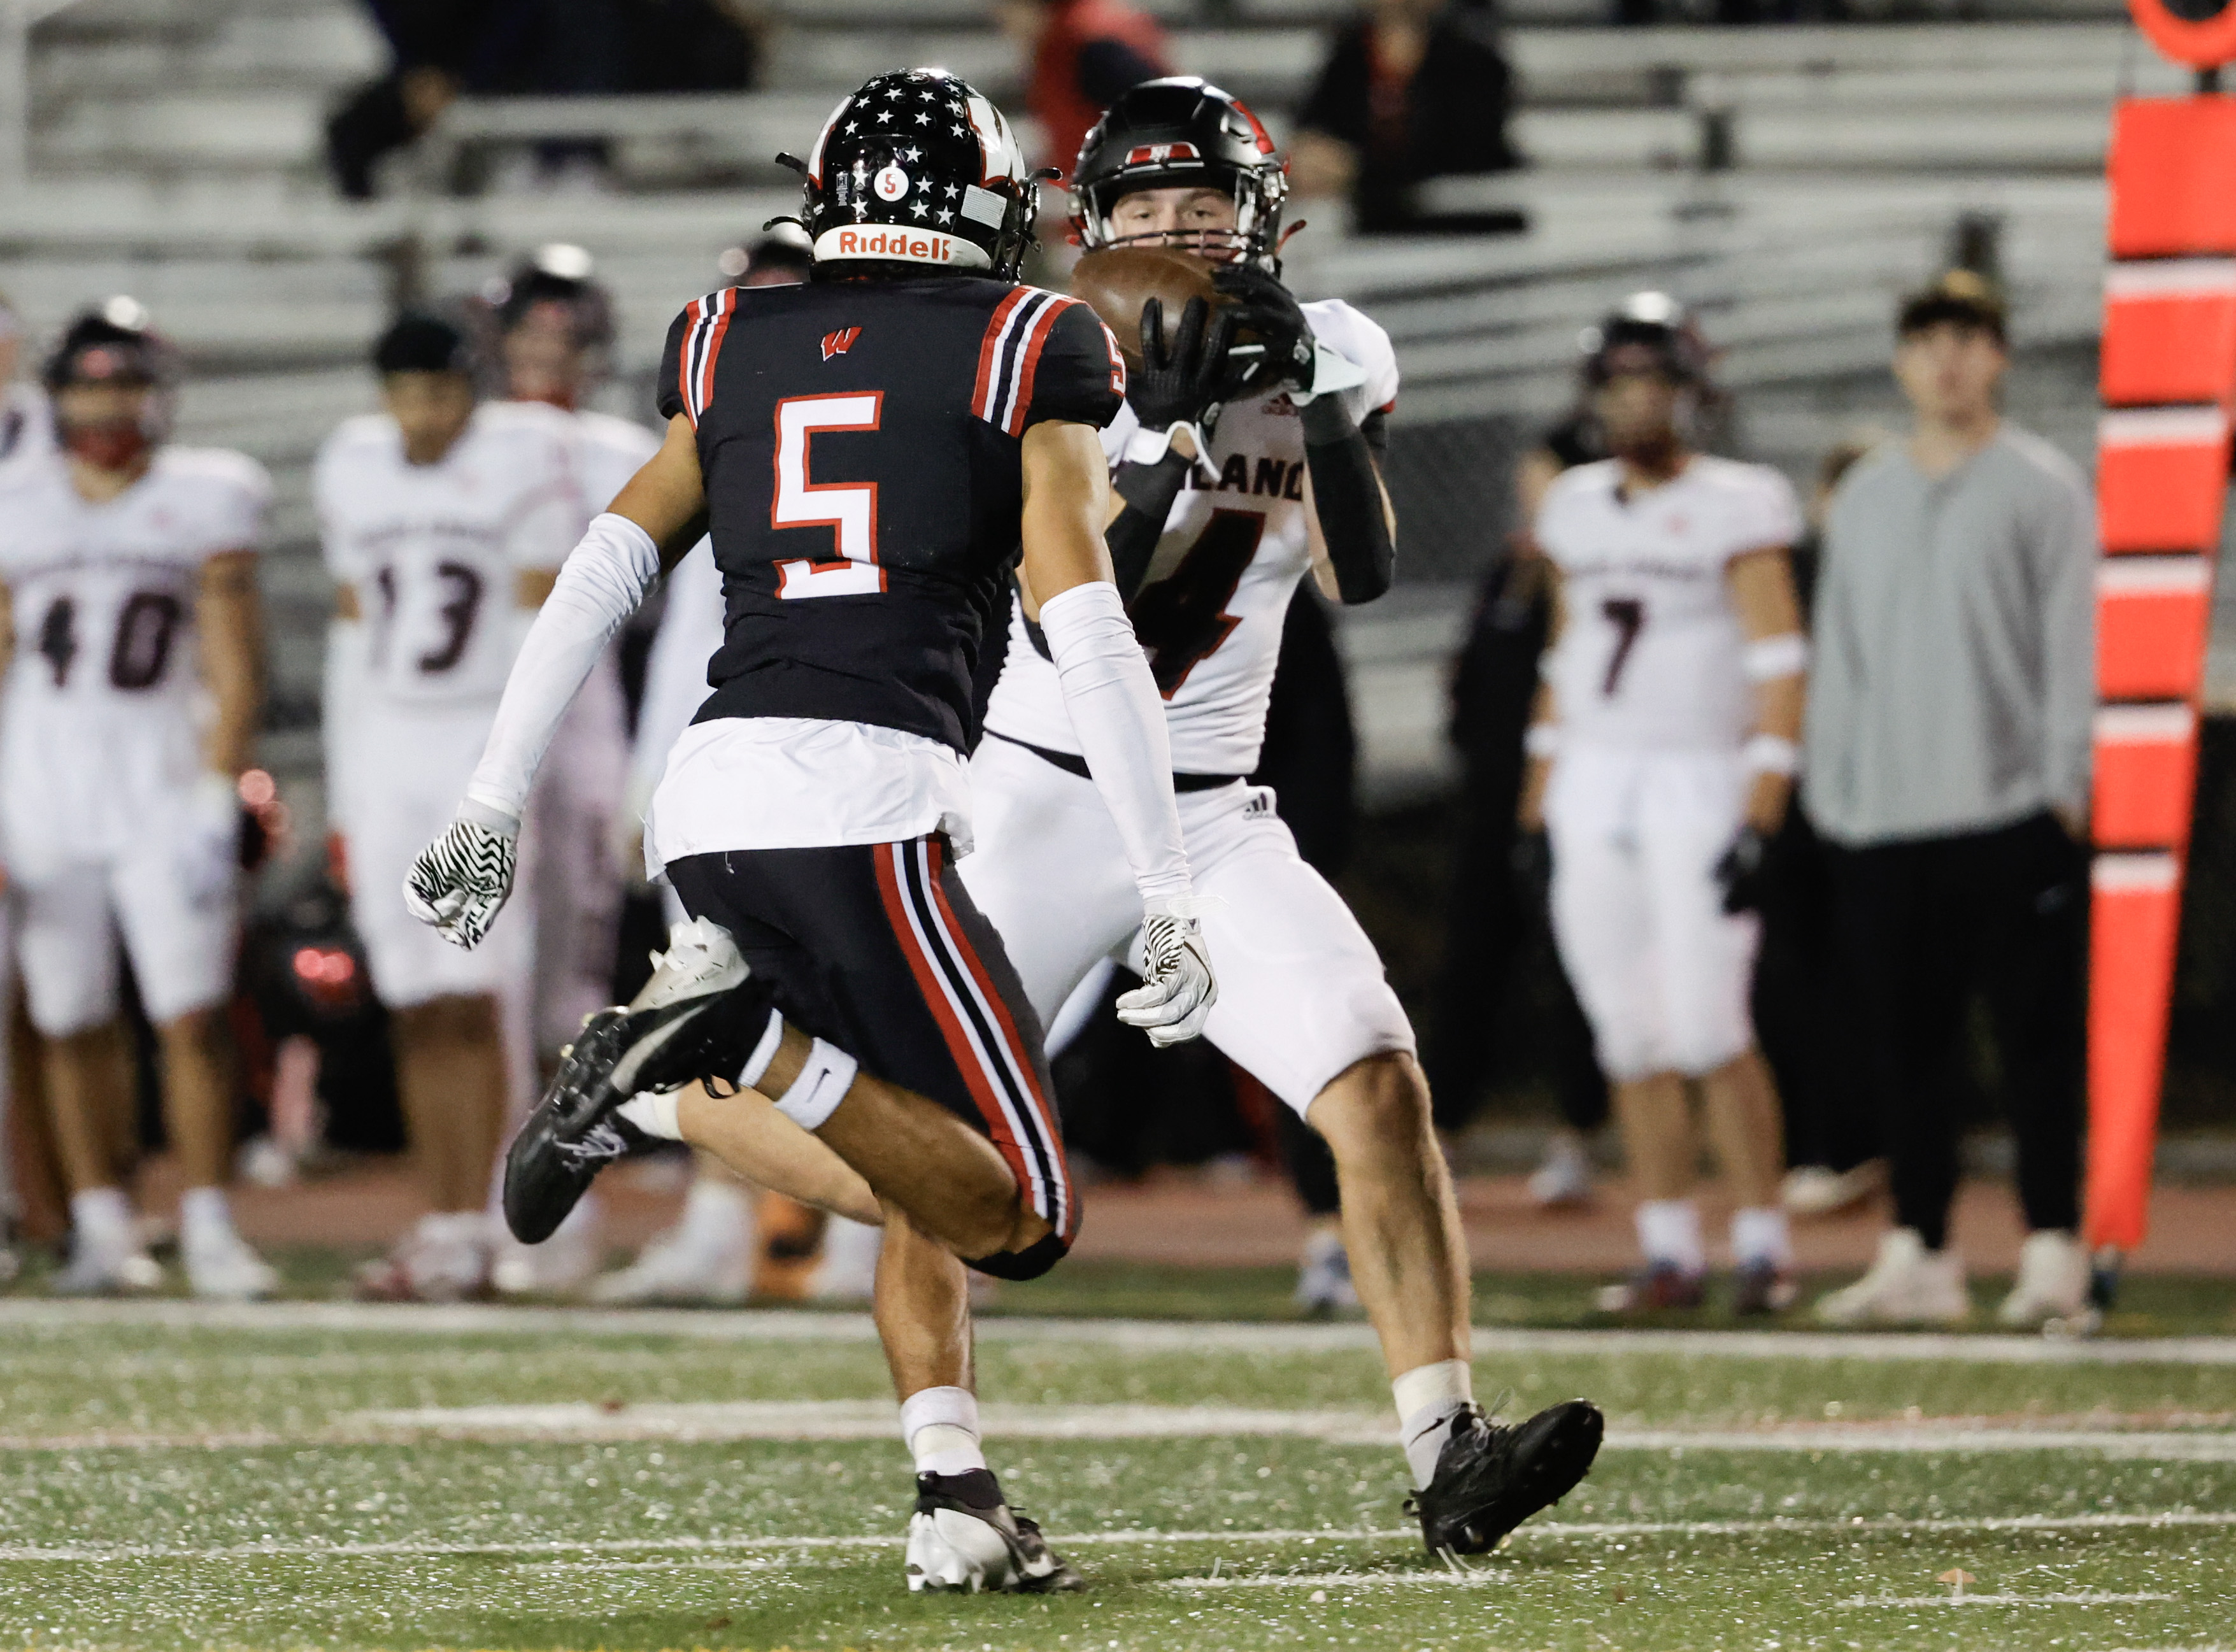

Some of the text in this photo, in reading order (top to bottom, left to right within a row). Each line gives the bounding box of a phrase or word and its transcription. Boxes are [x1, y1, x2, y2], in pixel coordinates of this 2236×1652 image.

[885, 173, 896, 194] 5
[839, 231, 951, 261] Riddell
[820, 326, 862, 362] W
[1099, 321, 1126, 399] 5
[771, 390, 888, 600] 5
[39, 592, 182, 690] 40
[377, 559, 483, 673] 13
[1126, 507, 1266, 702] 4
[1599, 595, 1643, 698] 7
